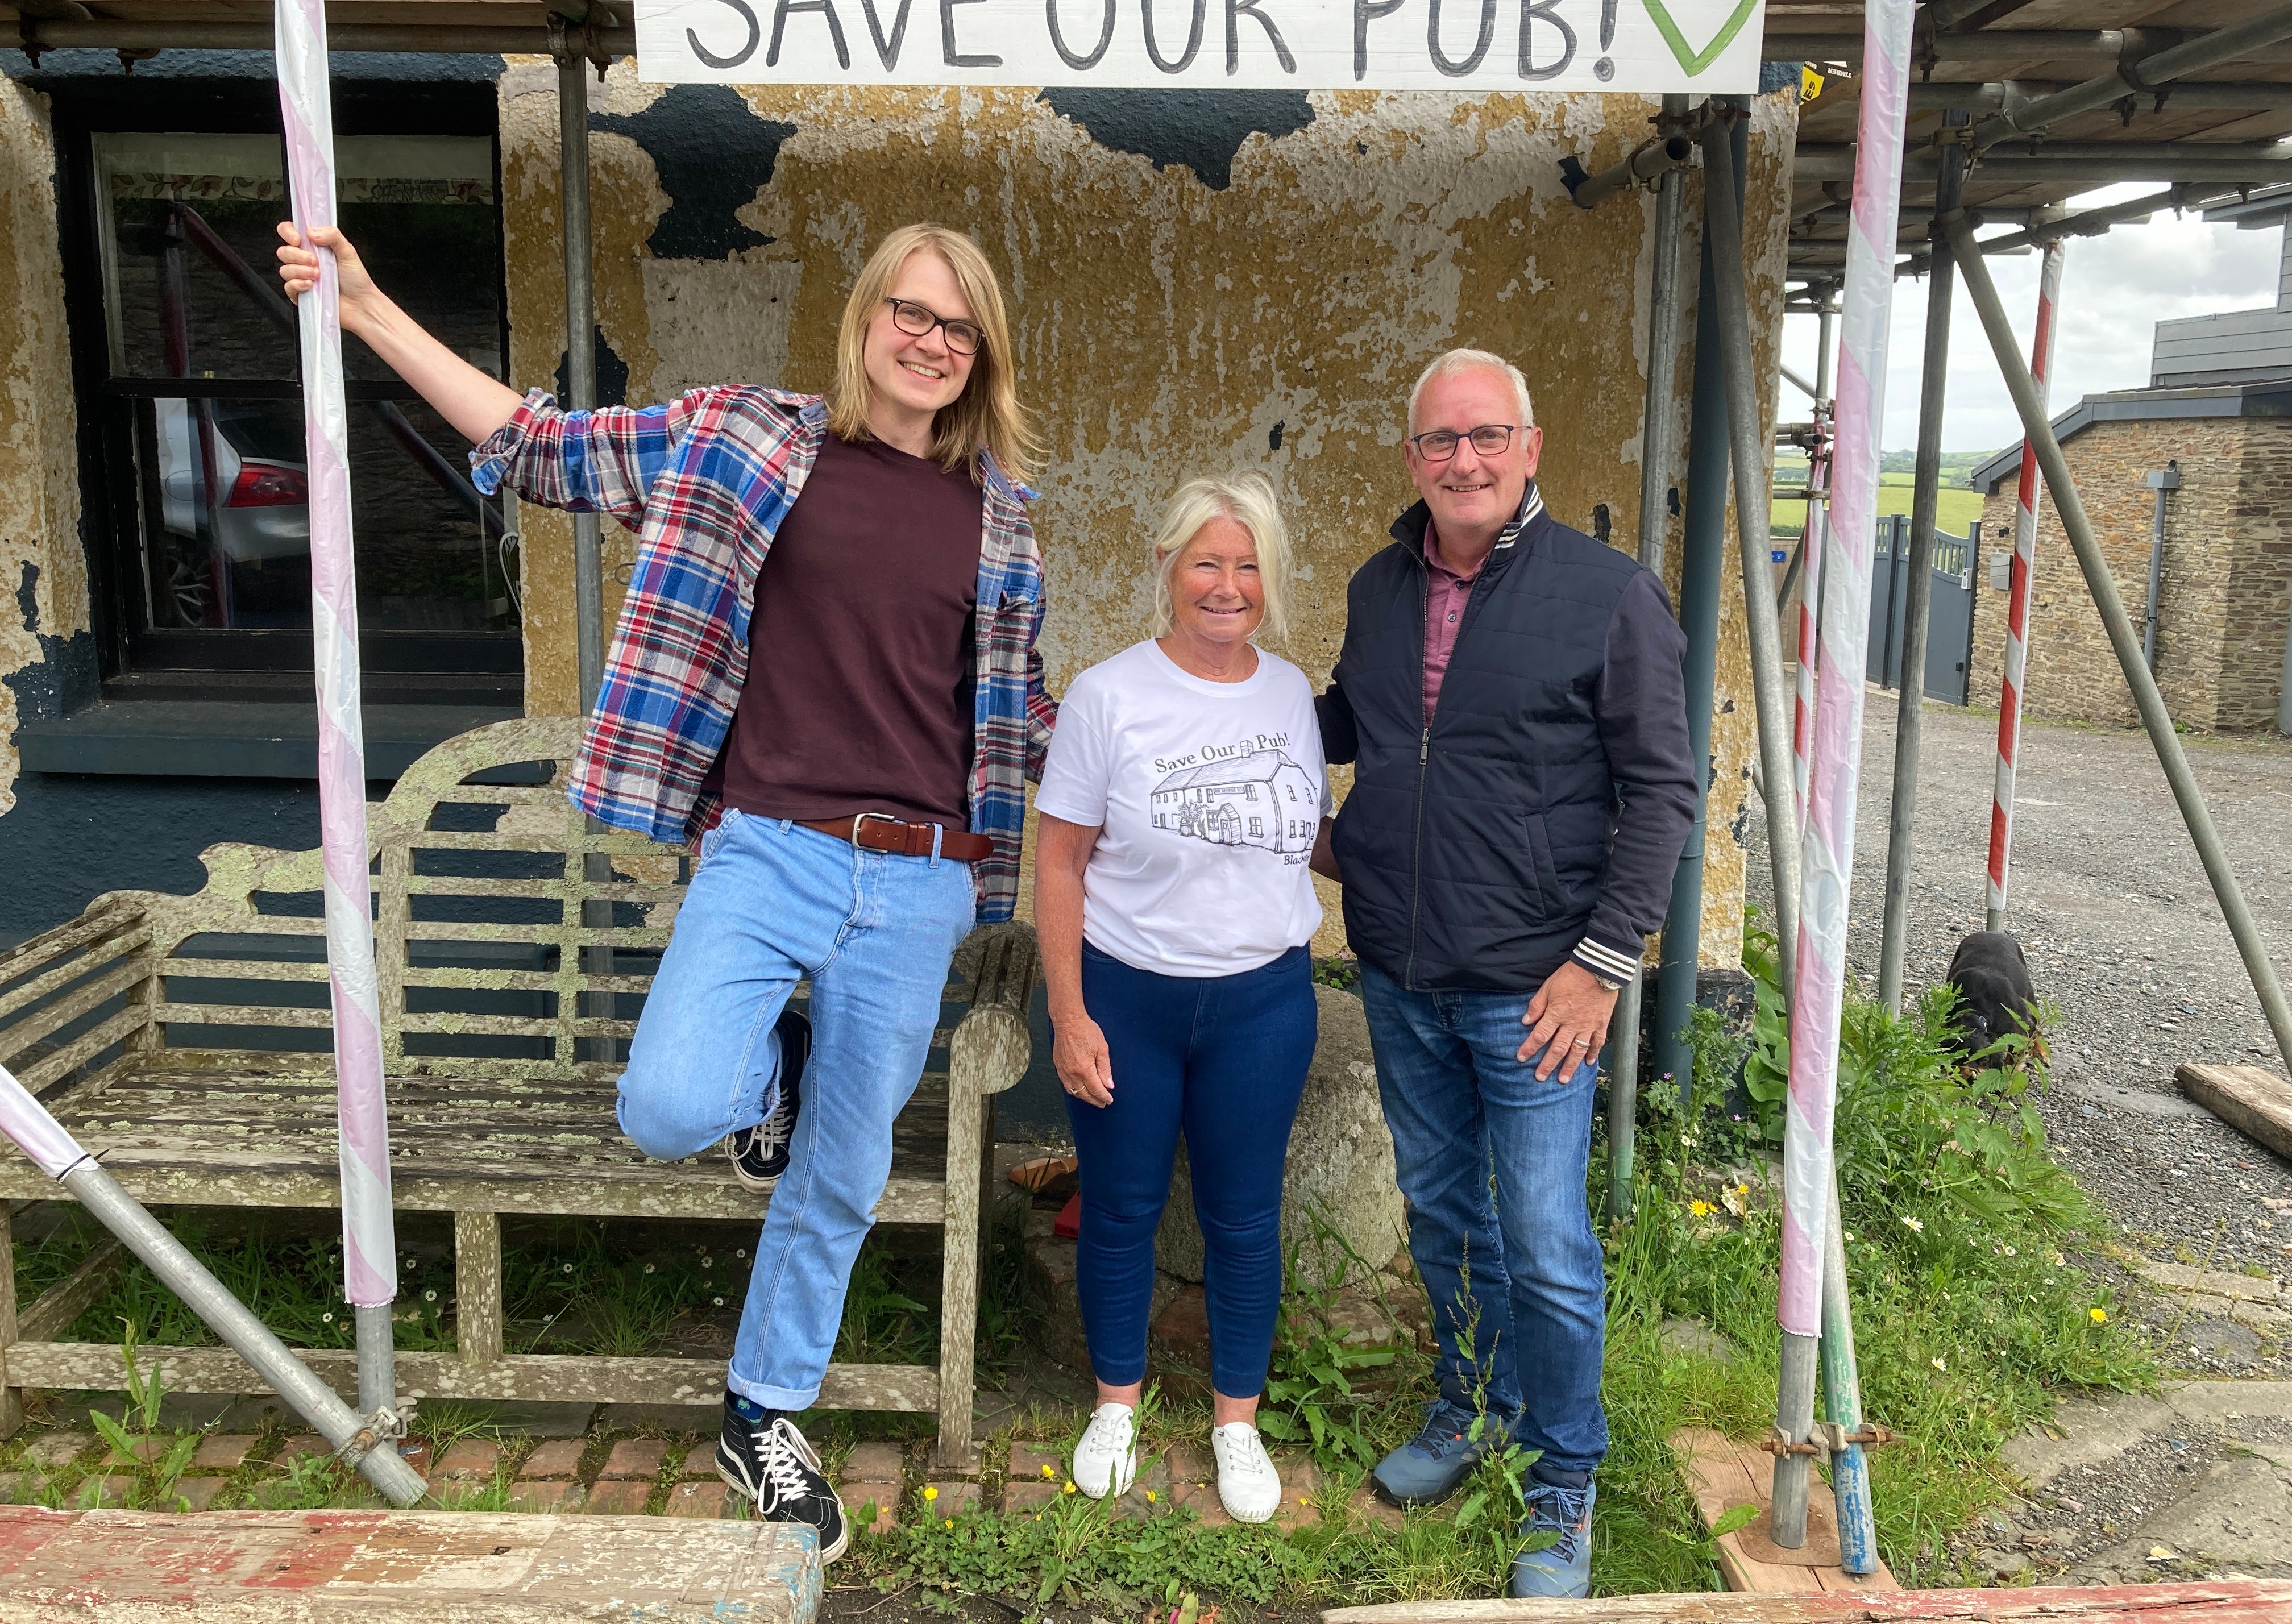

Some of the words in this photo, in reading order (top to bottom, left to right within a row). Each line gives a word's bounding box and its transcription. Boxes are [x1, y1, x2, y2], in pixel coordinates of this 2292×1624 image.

[1046, 0, 1297, 76] OUR
[1827, 68, 1852, 78] TIMBER
[1155, 754, 1197, 773] Save
[1201, 745, 1235, 761] Our
[1255, 732, 1290, 749] Pub!
